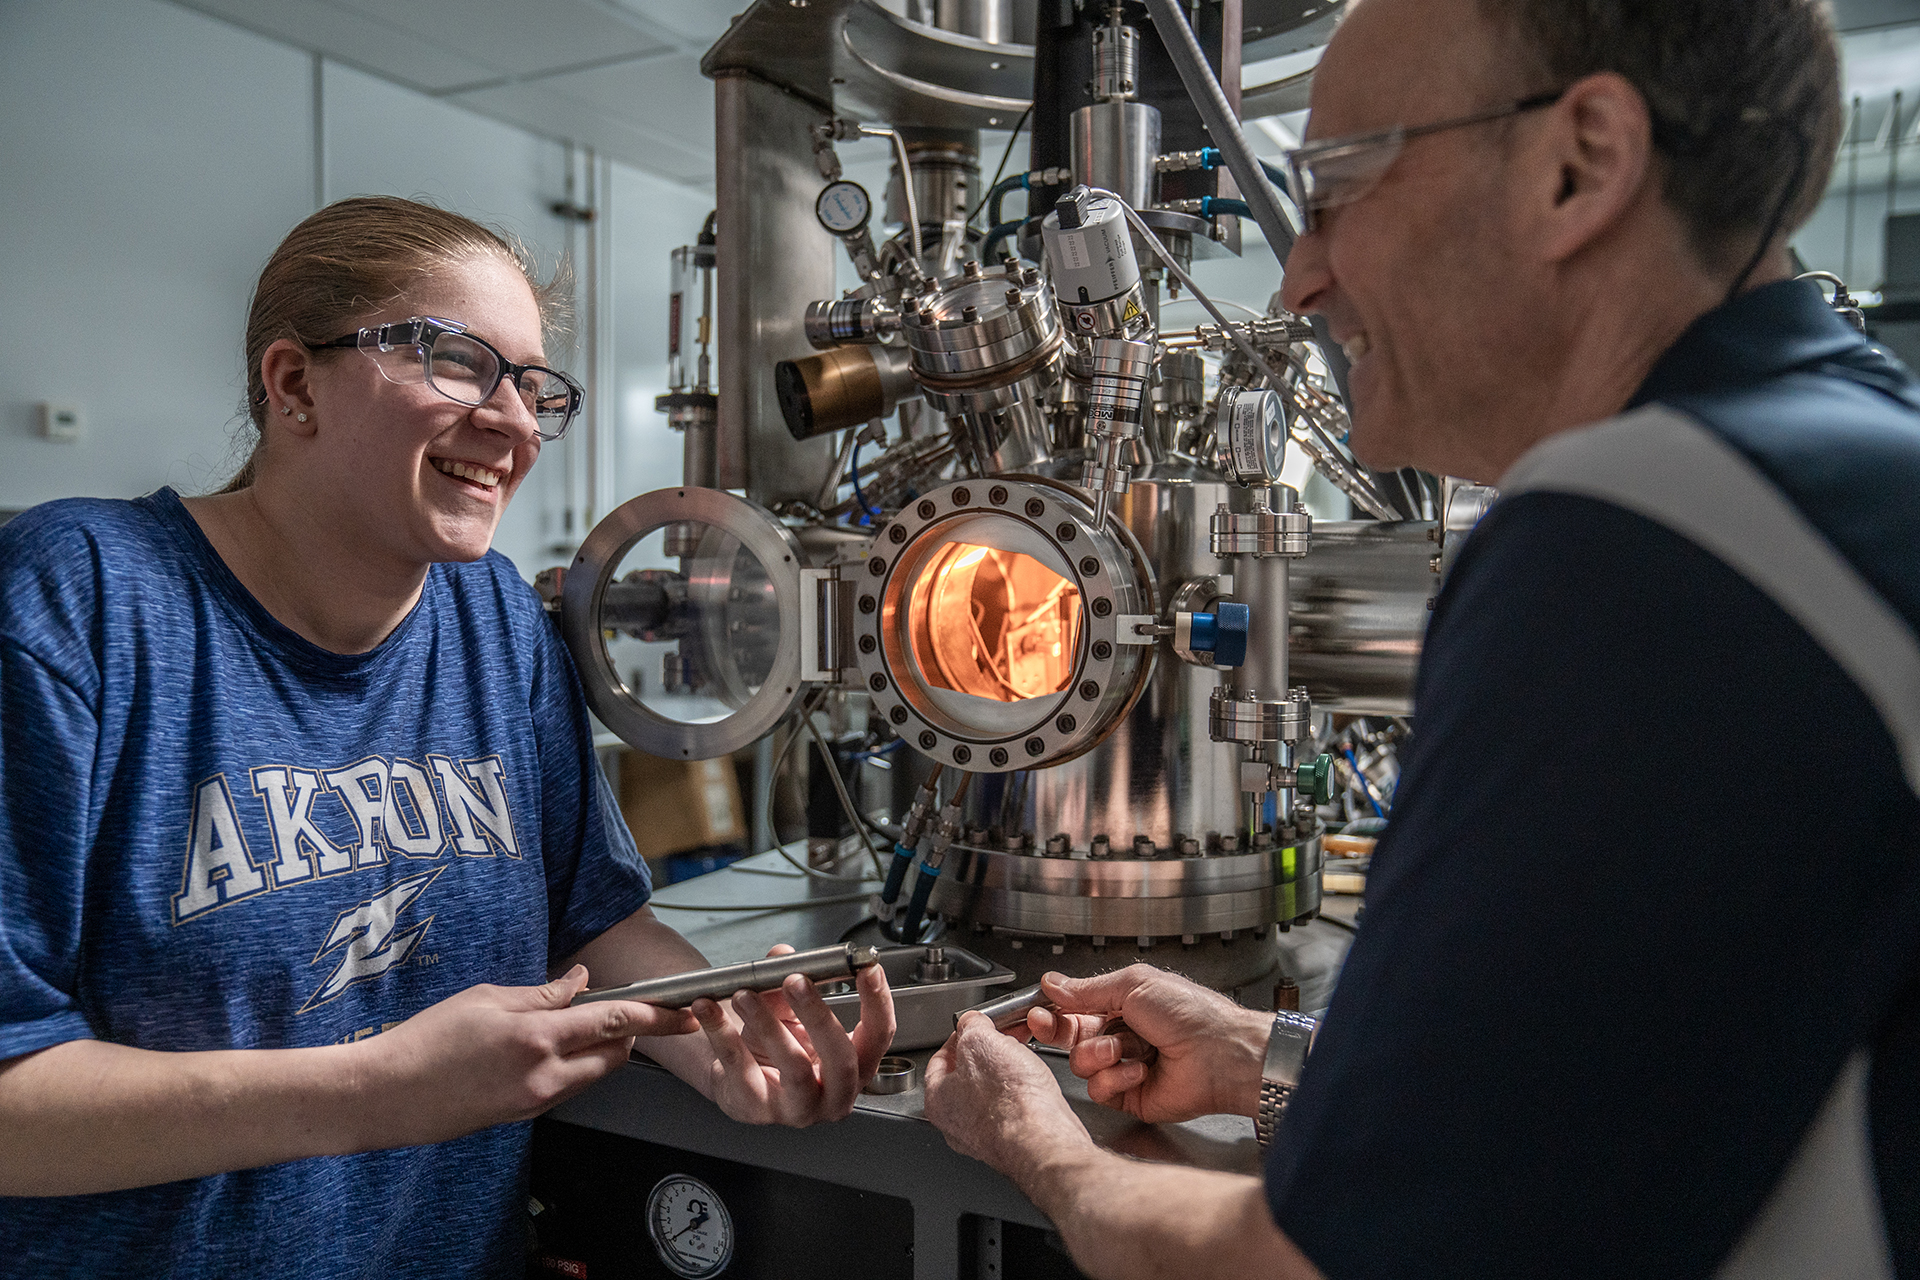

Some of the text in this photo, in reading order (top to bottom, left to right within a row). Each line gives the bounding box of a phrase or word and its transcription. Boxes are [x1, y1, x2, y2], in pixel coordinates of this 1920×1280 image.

[1101, 229, 1119, 291] PFEIFFER VACUUM
[171, 754, 522, 927] AKRON
[557, 1260, 579, 1274] PSIG
